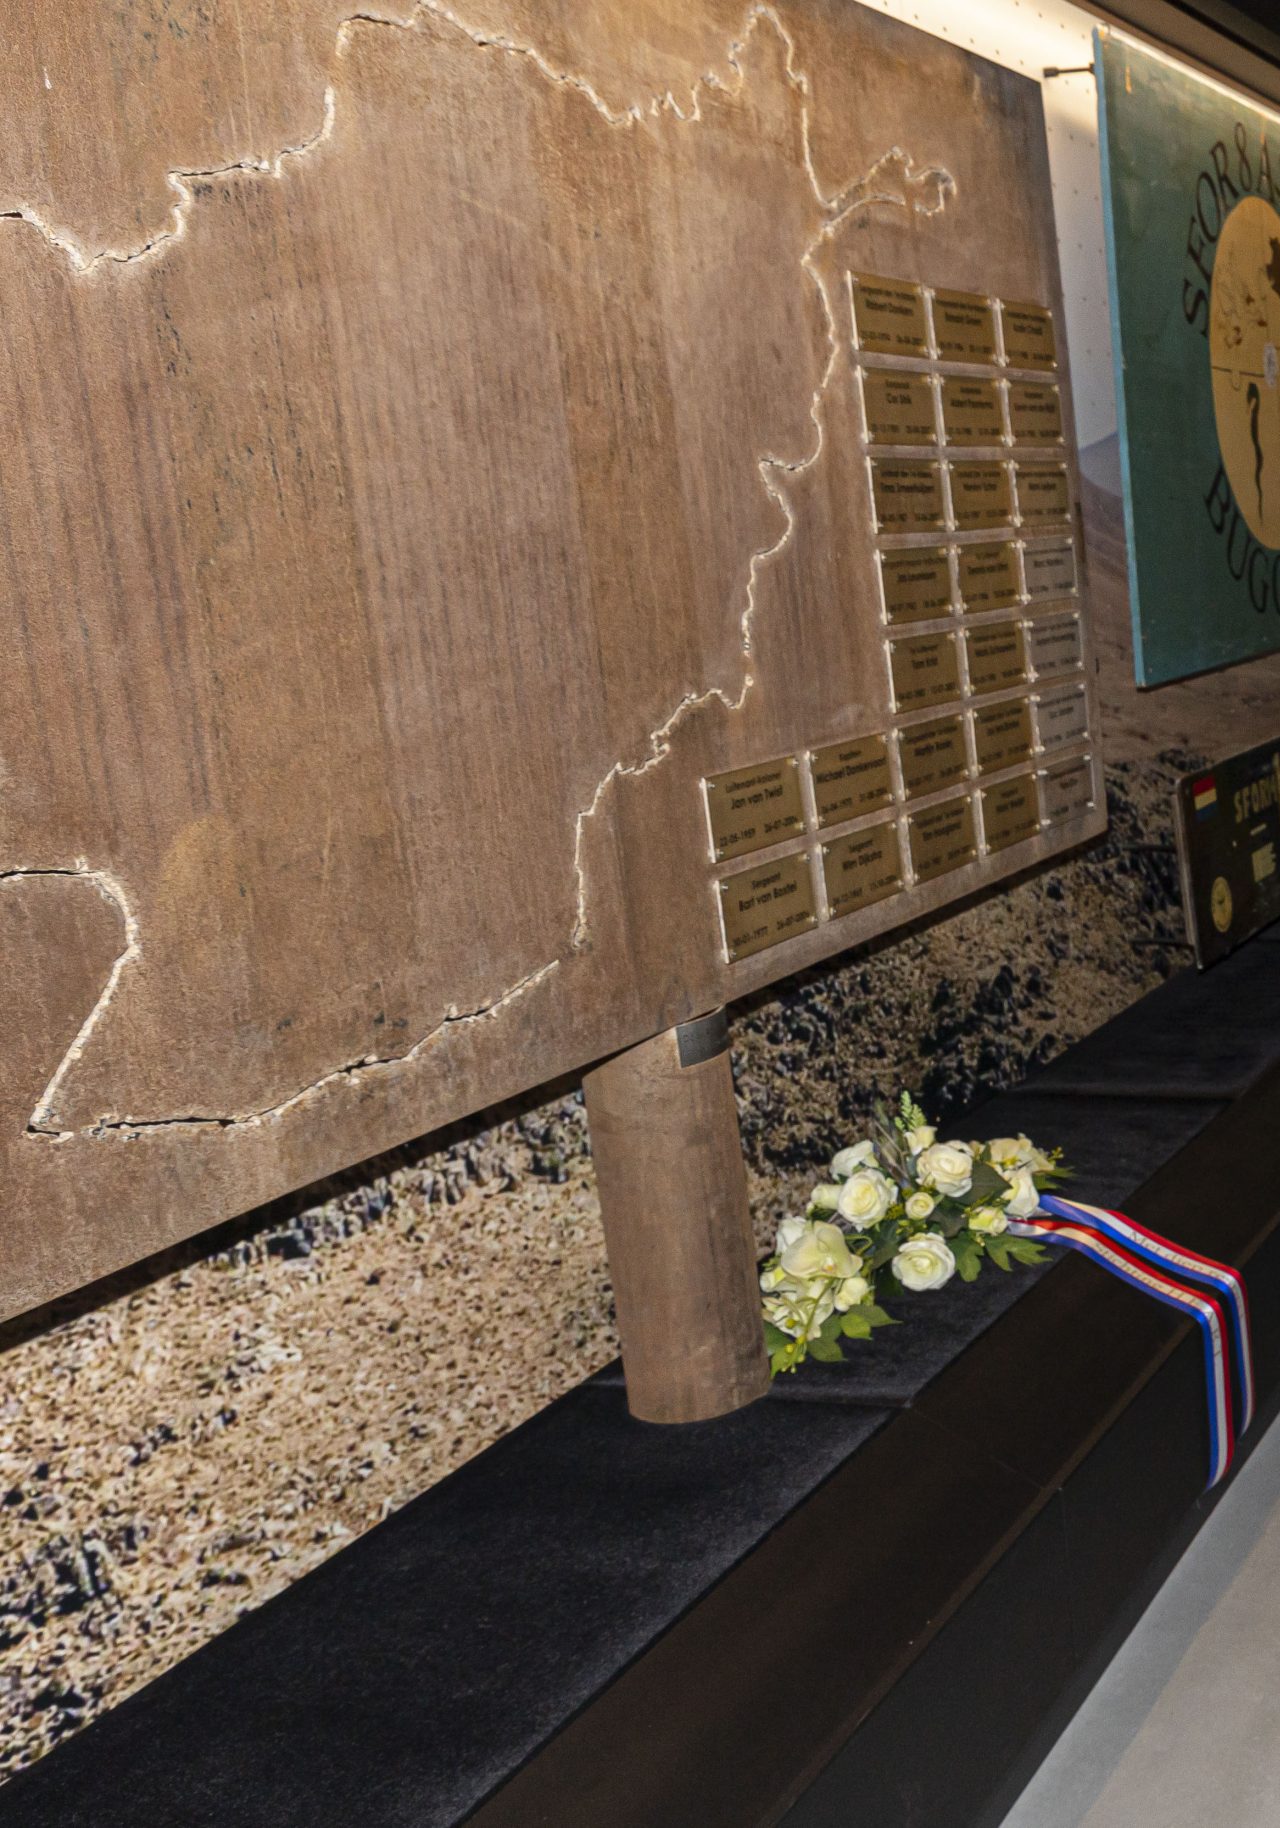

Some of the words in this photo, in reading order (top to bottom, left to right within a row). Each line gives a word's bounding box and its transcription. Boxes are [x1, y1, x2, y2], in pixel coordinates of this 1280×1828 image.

[1181, 139, 1240, 340] SFOR
[1234, 121, 1253, 194] 8
[731, 797, 746, 810] Jan
[747, 792, 764, 804] van
[755, 892, 773, 905] van
